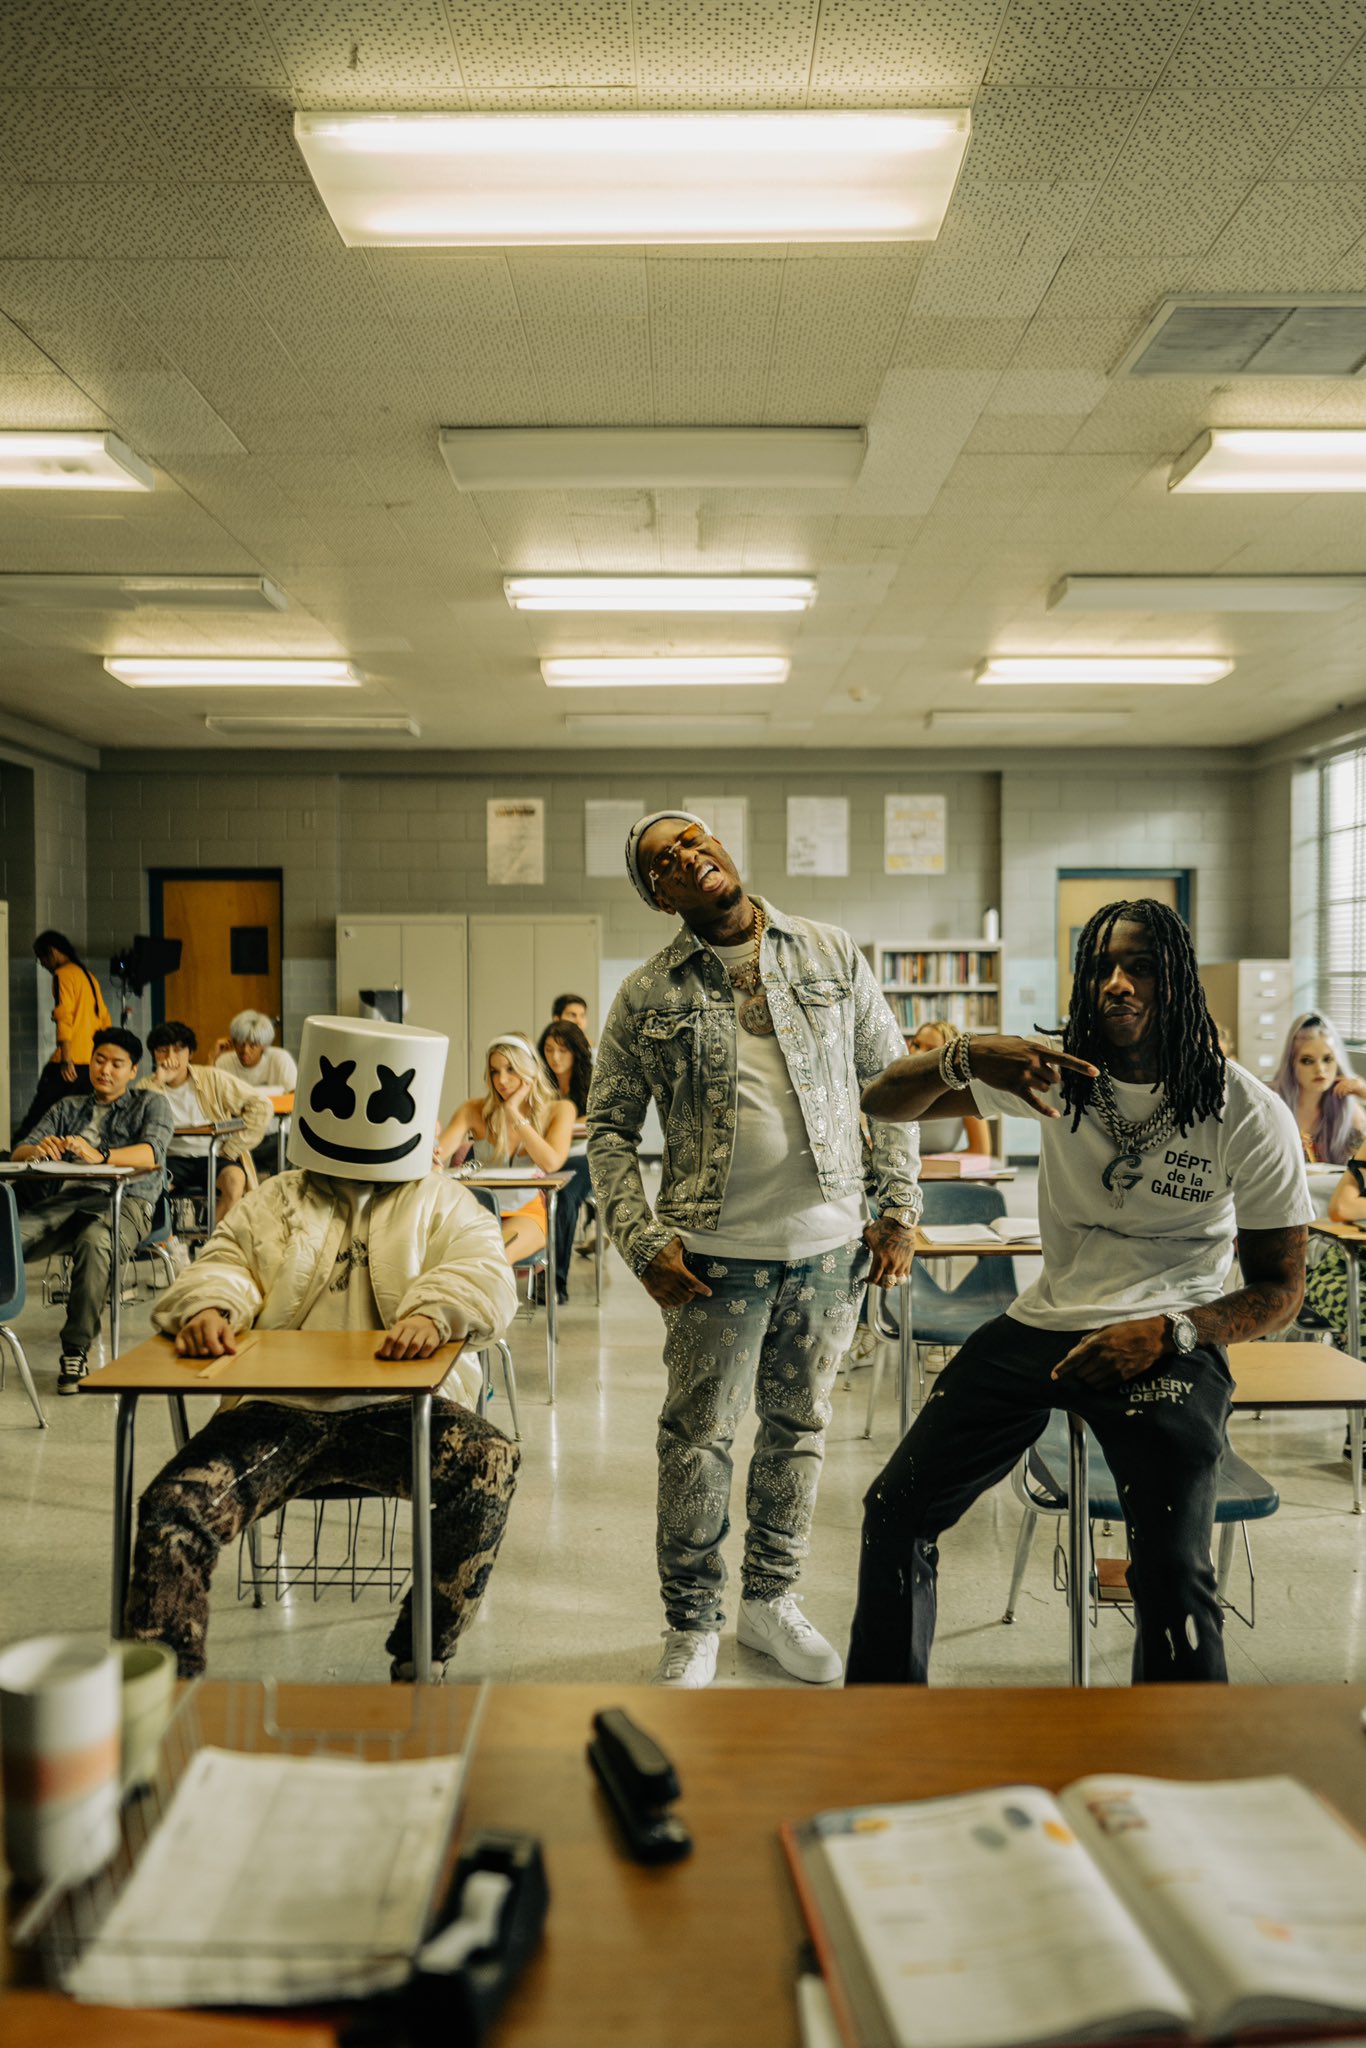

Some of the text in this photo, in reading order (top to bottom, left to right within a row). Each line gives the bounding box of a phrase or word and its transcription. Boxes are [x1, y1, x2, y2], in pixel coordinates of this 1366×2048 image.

[1164, 1150, 1212, 1174] DÉPT.
[1167, 1169, 1203, 1187] de la
[1120, 1378, 1193, 1394] GALLERY
[1130, 1391, 1183, 1404] DEPT.
